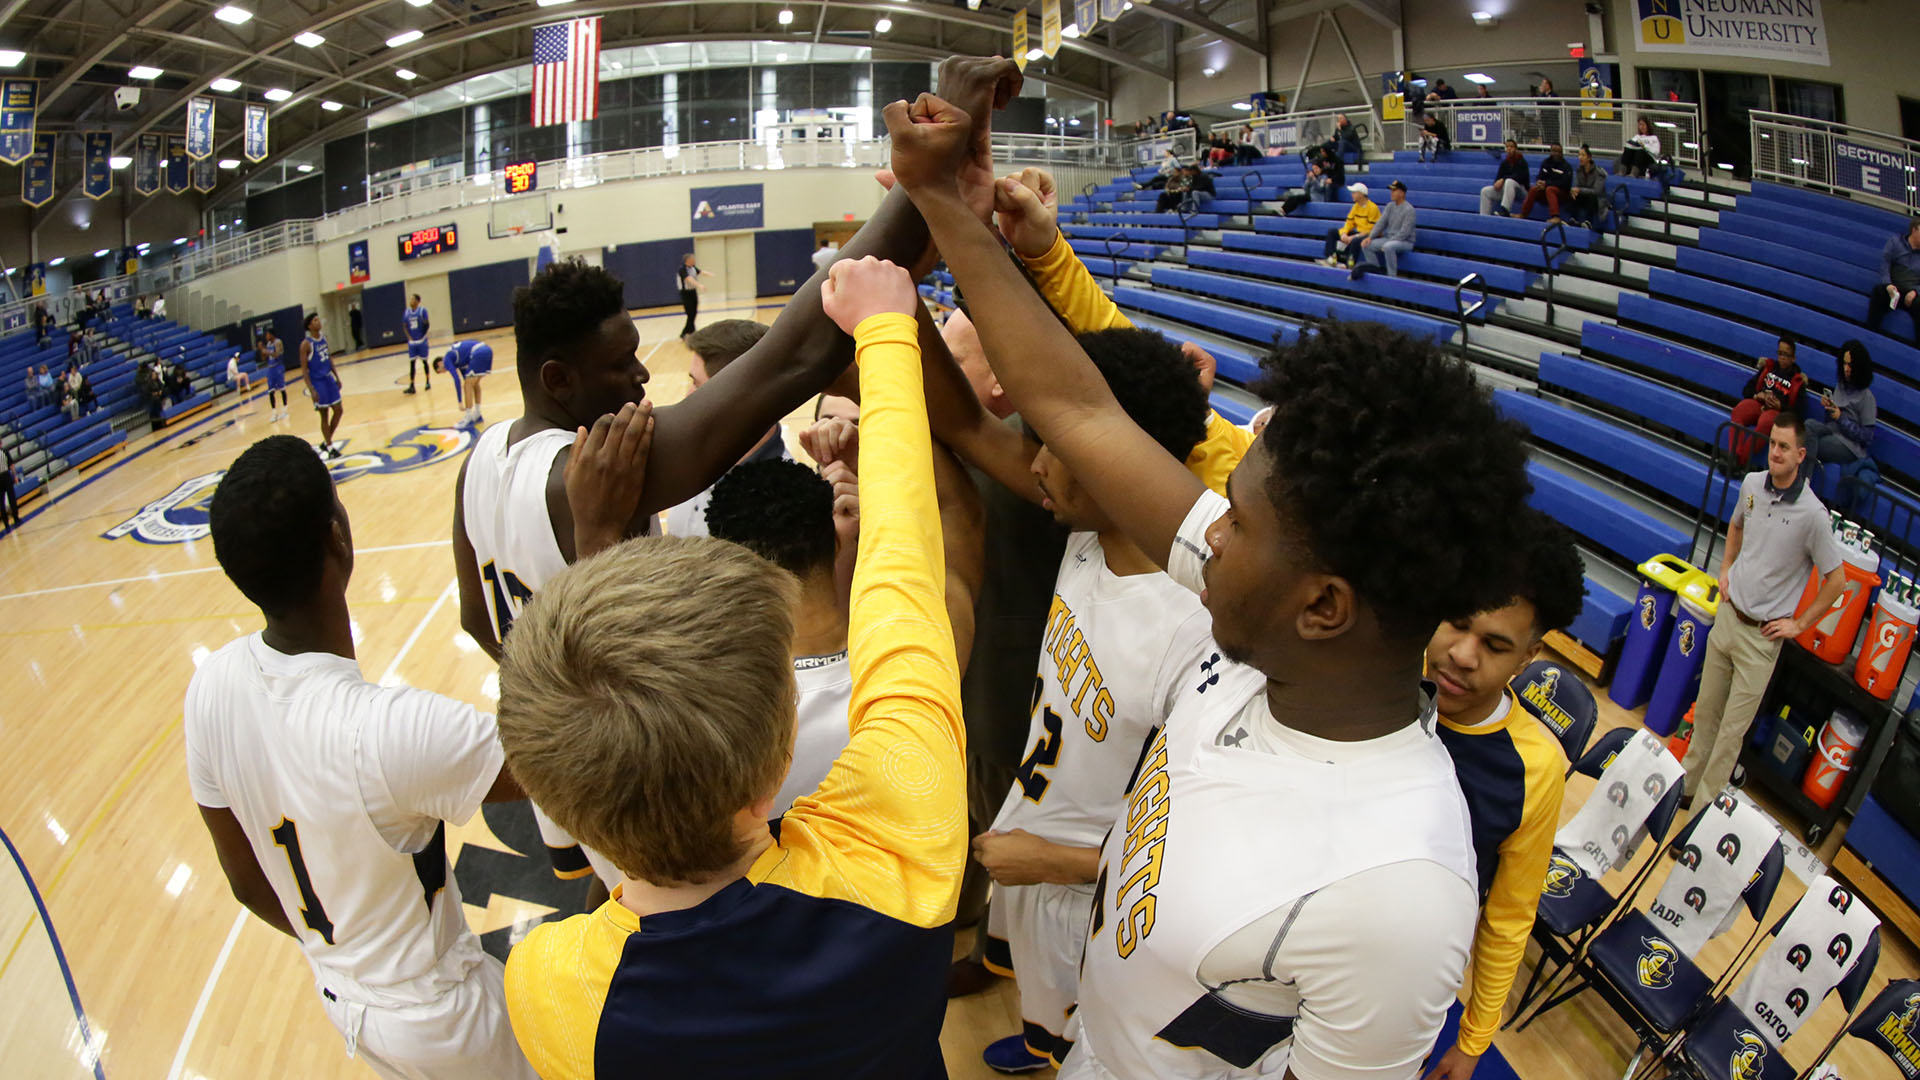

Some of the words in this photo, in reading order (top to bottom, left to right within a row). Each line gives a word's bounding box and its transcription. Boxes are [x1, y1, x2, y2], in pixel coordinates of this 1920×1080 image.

[1687, 13, 1818, 46] UNIVERSITY
[1457, 112, 1501, 122] SECTION
[1471, 124, 1487, 141] D
[1837, 144, 1902, 170] SECTION
[505, 162, 535, 179] 20:00
[1861, 165, 1881, 192] E
[512, 175, 530, 192] 30
[411, 227, 439, 246] 20:00
[446, 231, 456, 245] 0
[404, 240, 413, 255] 0
[794, 650, 848, 668] ARMOU
[1522, 682, 1573, 729] NEUMANN
[269, 812, 337, 947] 1
